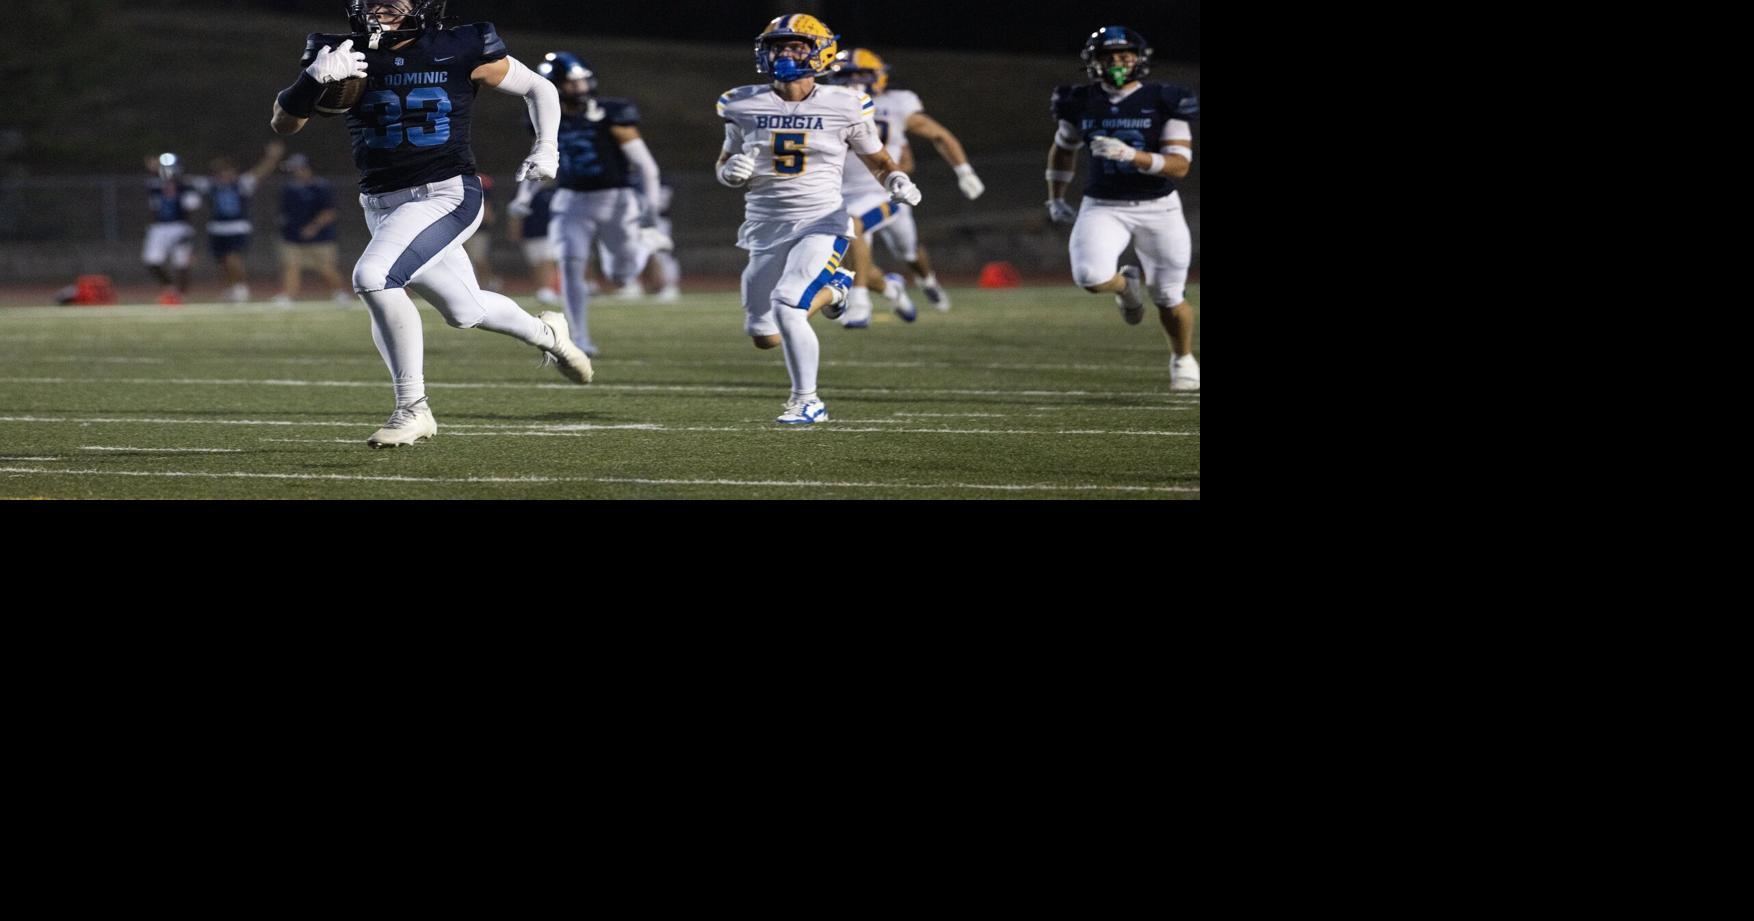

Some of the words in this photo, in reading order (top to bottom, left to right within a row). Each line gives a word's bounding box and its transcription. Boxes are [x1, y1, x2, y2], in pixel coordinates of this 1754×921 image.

[384, 71, 448, 86] DOMINIC
[361, 86, 452, 149] 33
[756, 115, 824, 130] BORGIA
[772, 131, 807, 177] 5
